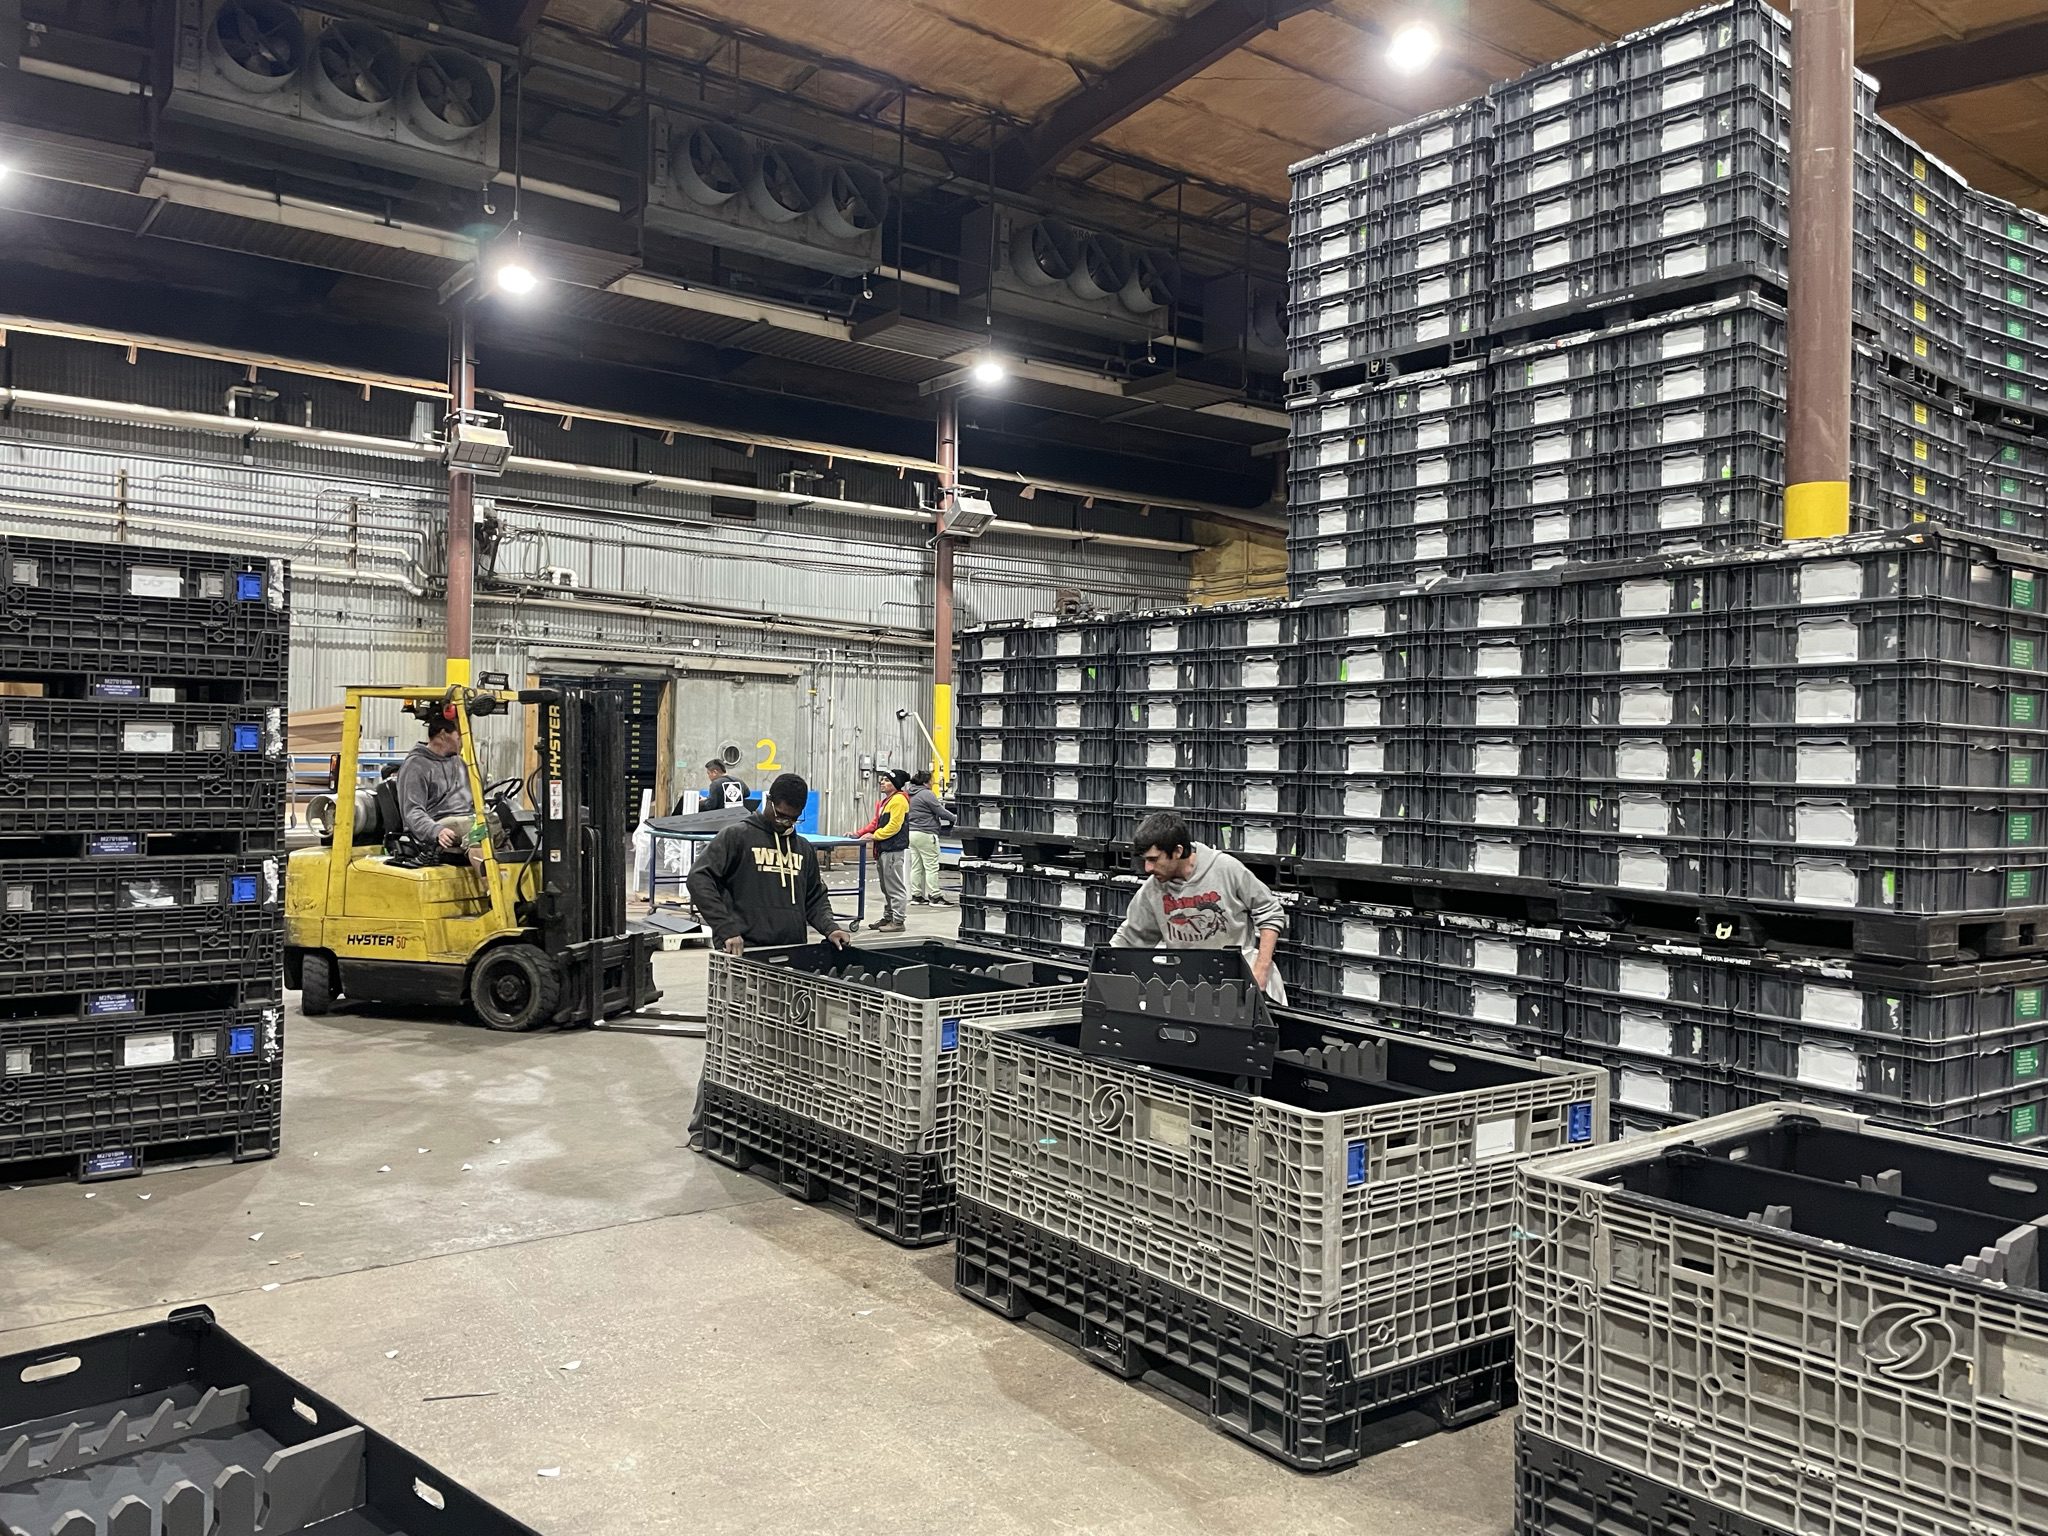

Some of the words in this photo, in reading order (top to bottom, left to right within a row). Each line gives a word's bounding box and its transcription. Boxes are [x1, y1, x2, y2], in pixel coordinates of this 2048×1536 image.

[549, 704, 561, 777] HYSTER
[756, 738, 782, 770] 2
[728, 790, 738, 798] 22
[751, 847, 804, 870] WMU
[347, 934, 395, 946] HYSTER
